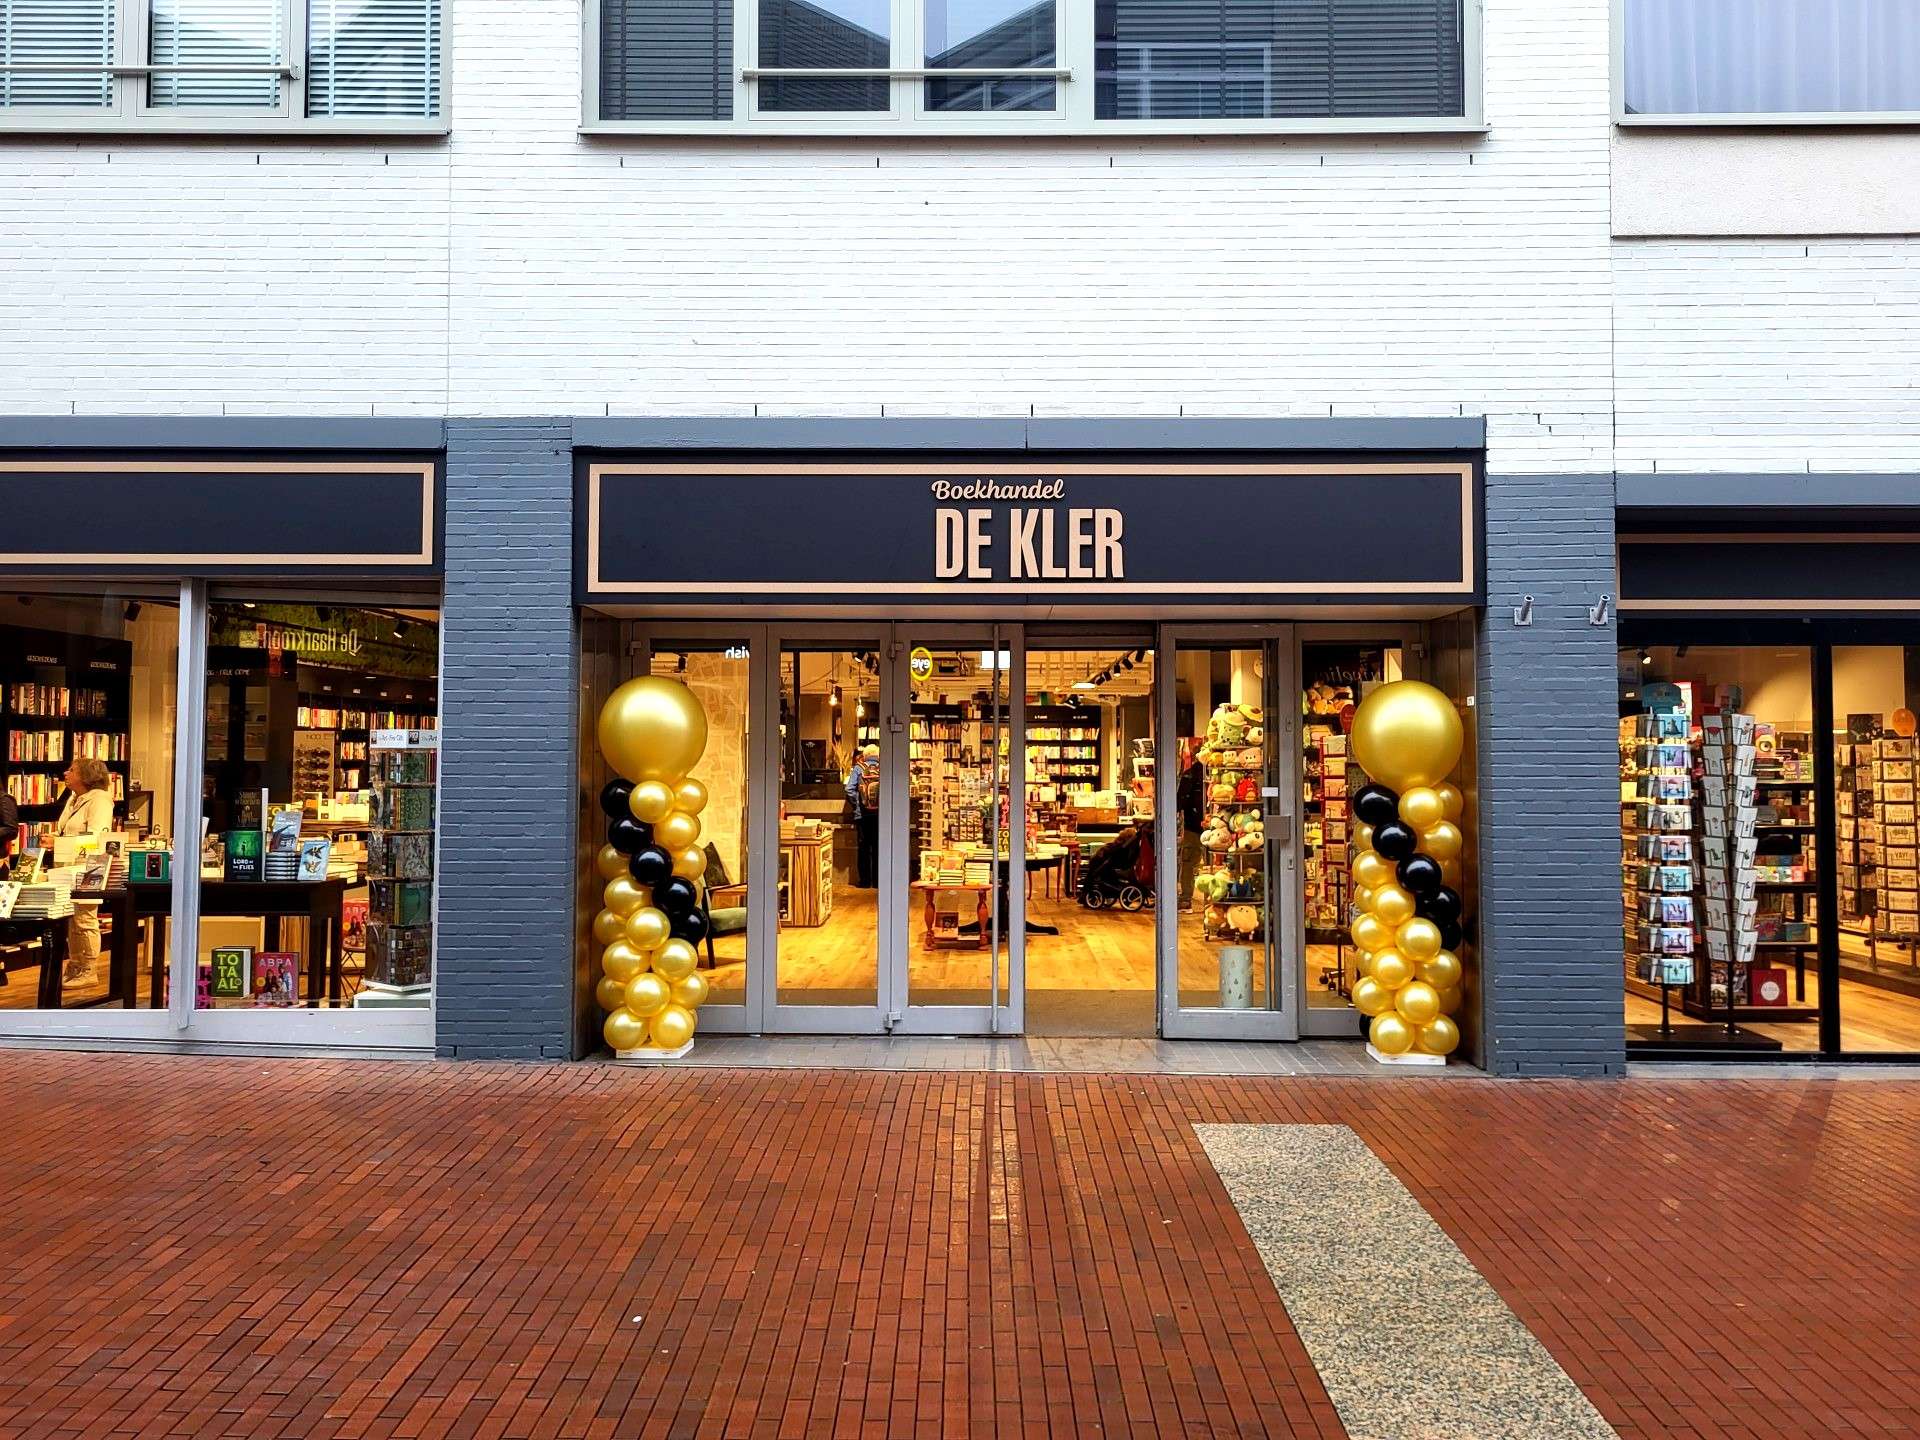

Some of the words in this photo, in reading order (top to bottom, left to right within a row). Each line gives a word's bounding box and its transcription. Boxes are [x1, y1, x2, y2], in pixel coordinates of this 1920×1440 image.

[931, 478, 1065, 500] Boekhandel
[935, 508, 992, 579] DE
[1010, 508, 1124, 579] KLER
[216, 954, 239, 965] TO
[217, 966, 237, 978] TA
